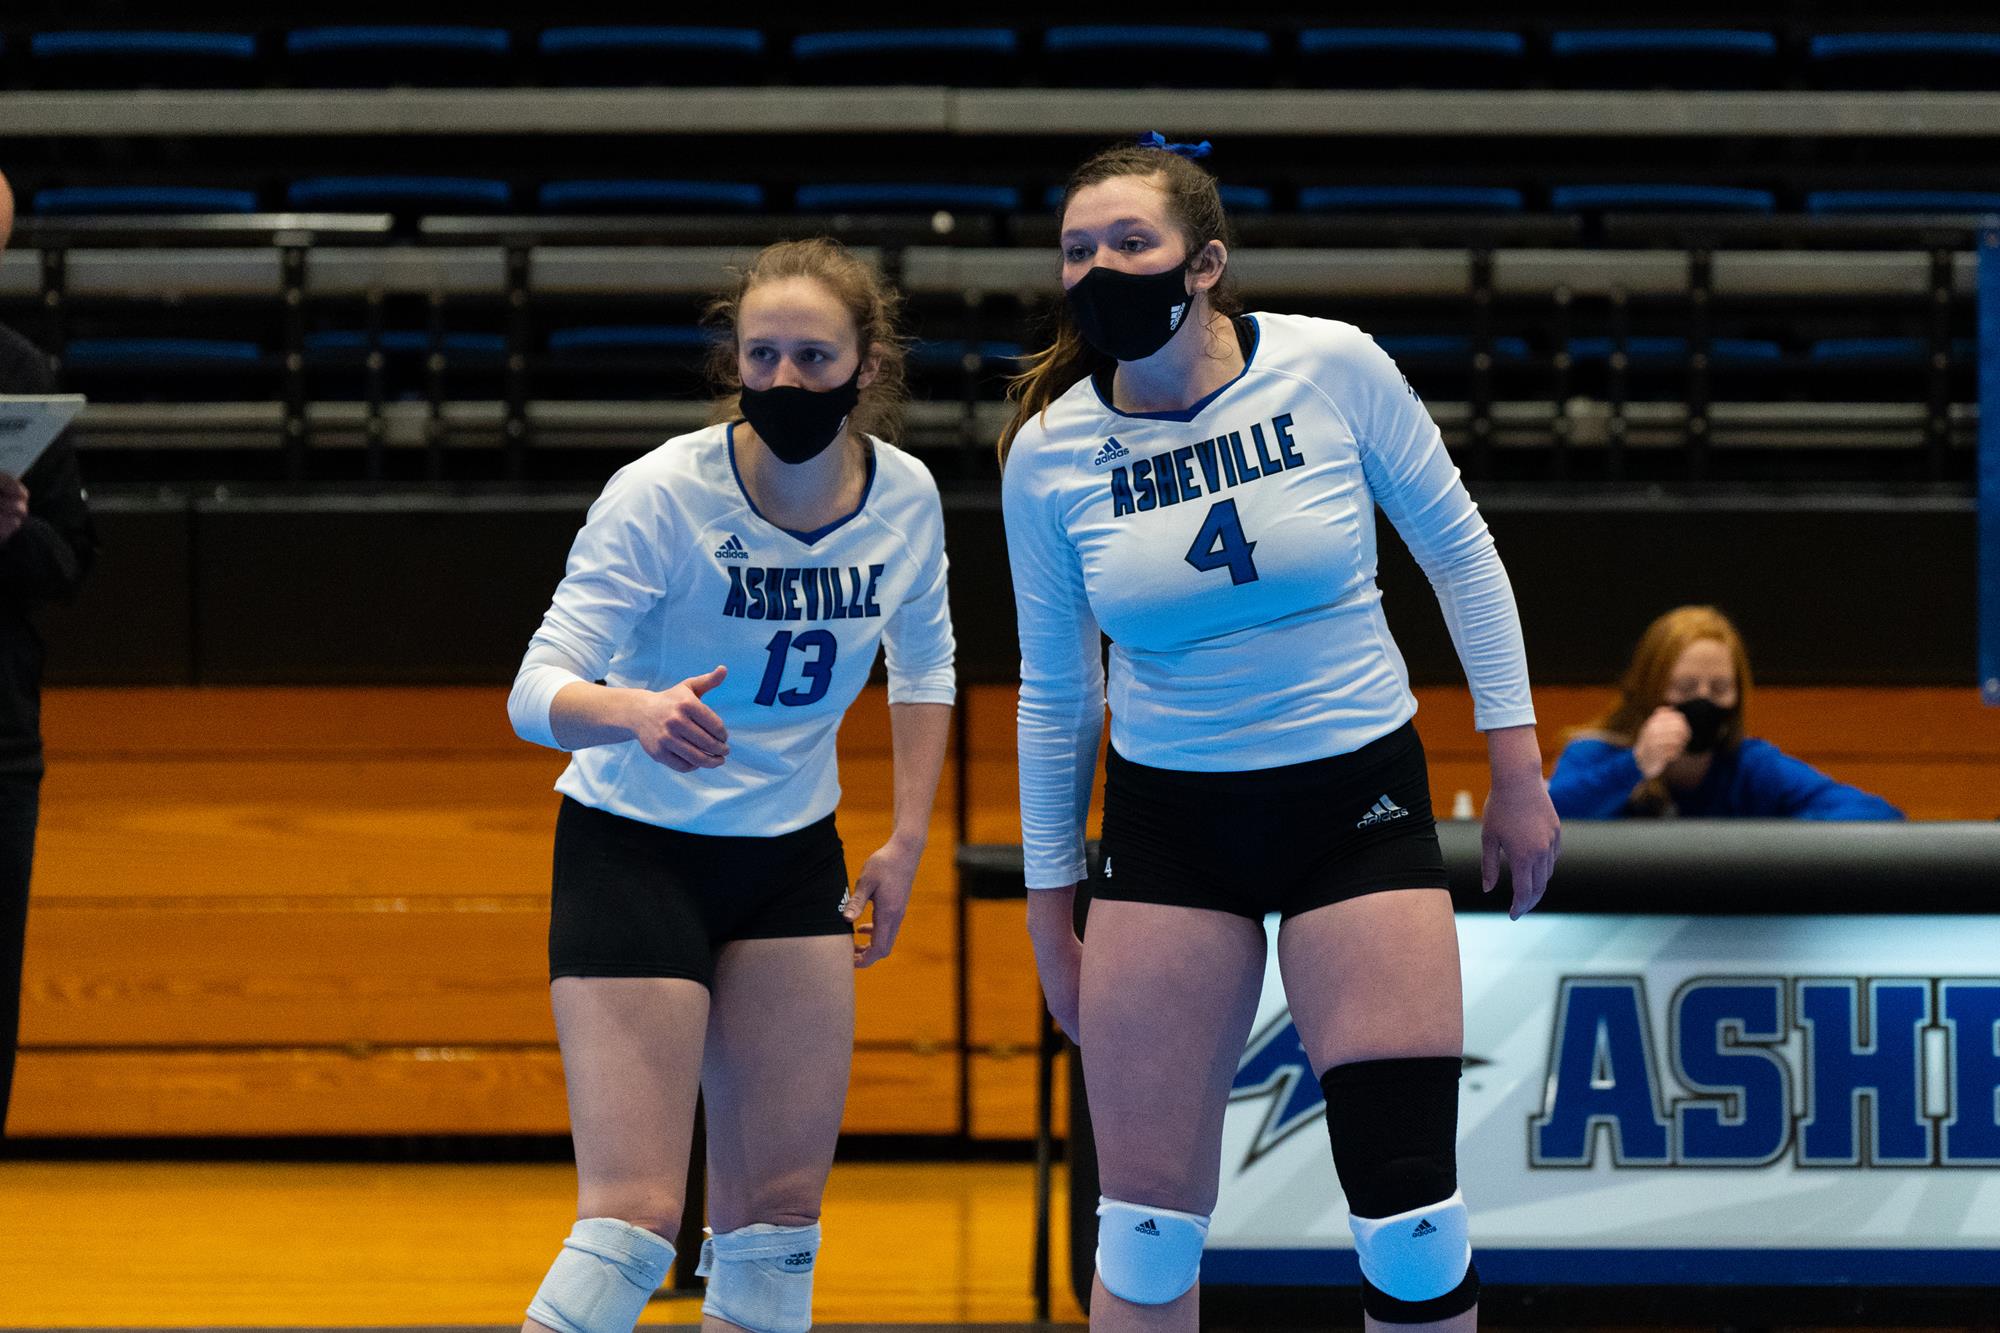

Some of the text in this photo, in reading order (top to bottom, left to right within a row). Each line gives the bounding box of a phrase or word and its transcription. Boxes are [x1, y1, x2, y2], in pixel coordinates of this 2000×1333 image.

[1094, 447, 1130, 466] adidas
[1111, 412, 1305, 518] ASHEVILLE
[714, 549, 749, 560] adidas
[1184, 497, 1259, 586] 4
[722, 563, 885, 621] ASHEVILLE
[753, 629, 838, 707] 13
